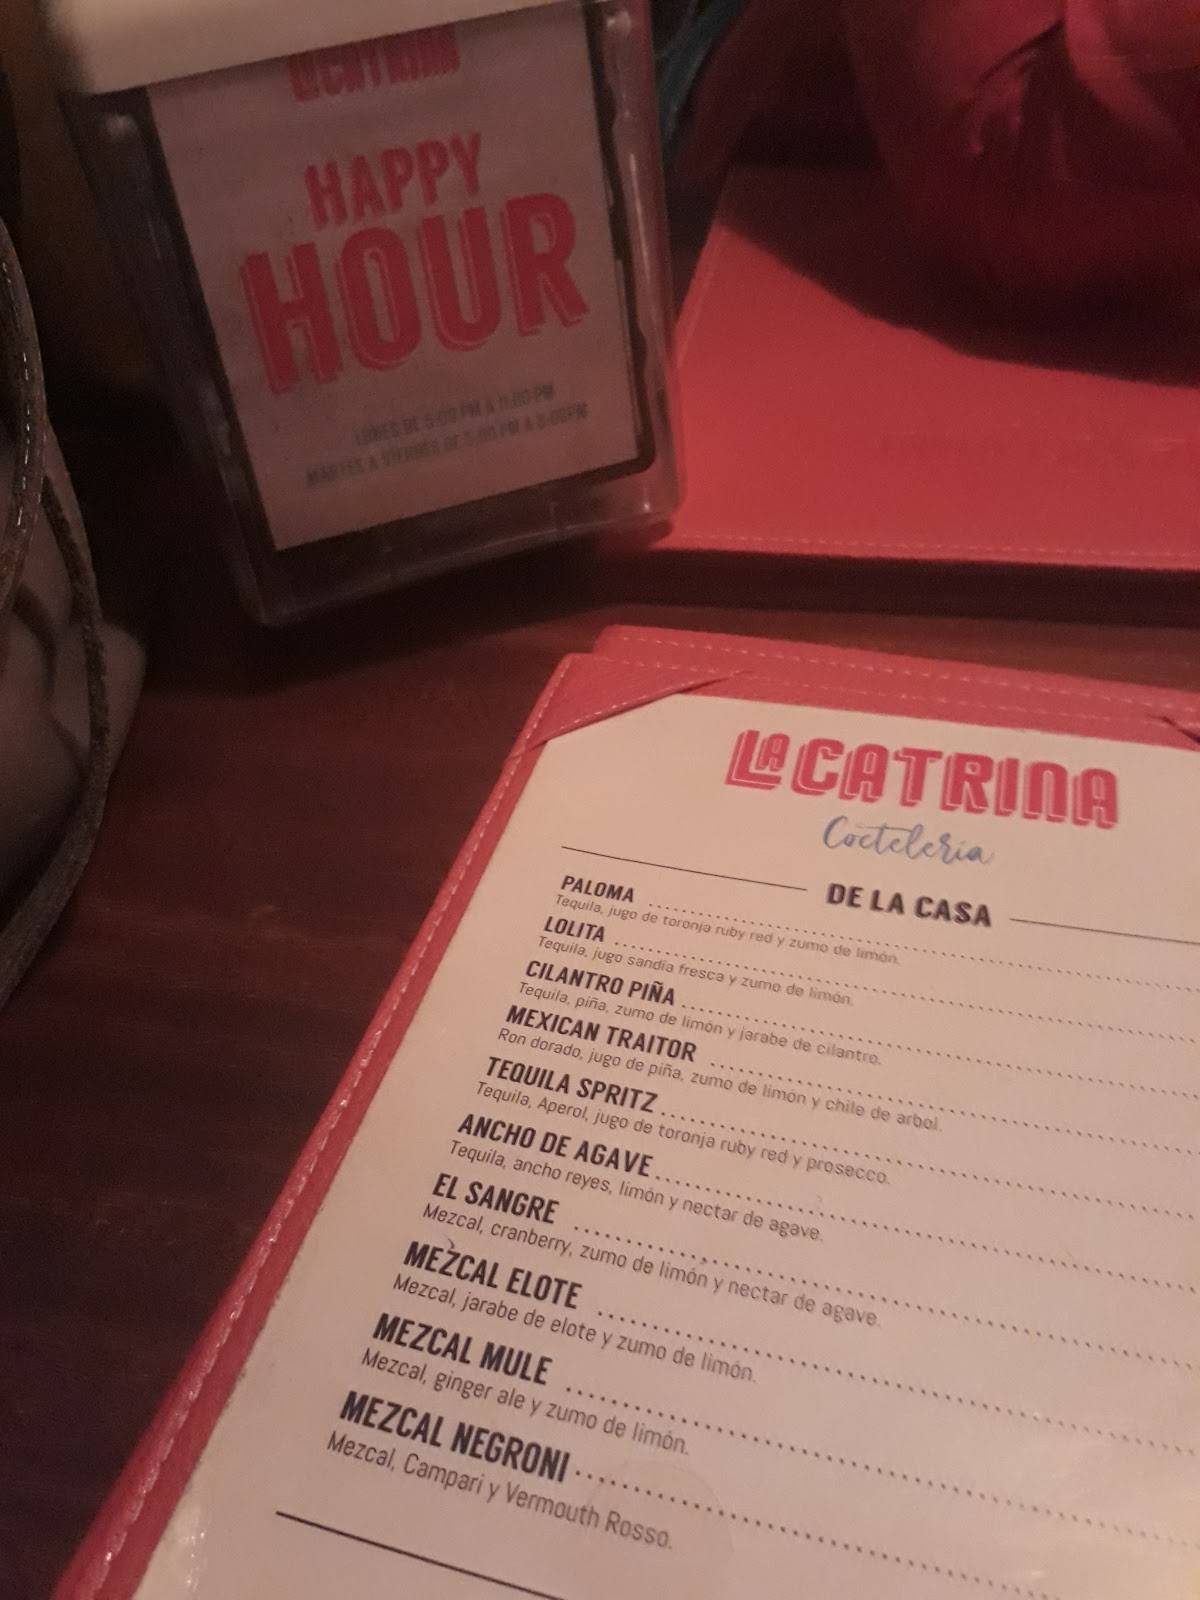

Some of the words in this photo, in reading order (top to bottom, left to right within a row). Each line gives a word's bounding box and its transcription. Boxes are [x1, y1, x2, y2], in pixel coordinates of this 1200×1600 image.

[304, 132, 482, 231] HAPPY
[239, 192, 590, 395] HOUR
[724, 729, 791, 790] LA
[791, 737, 1119, 830] CATRINA
[556, 893, 603, 915] Tequila,
[607, 907, 639, 921] jugo
[641, 911, 659, 924] de
[663, 915, 712, 934] toronja
[715, 926, 746, 941] ruby
[749, 932, 774, 944] red
[776, 936, 786, 948] y
[788, 938, 829, 953] zumo
[833, 944, 852, 957] de
[856, 947, 901, 964] limón.
[560, 874, 634, 904] PALOMA
[825, 881, 864, 908] DE
[868, 887, 906, 915] LA
[913, 894, 992, 927] CASA
[543, 915, 605, 943] LOLITA
[525, 960, 625, 995] CILANTRO
[627, 980, 675, 1007] PIÑA
[538, 935, 588, 958] Tequila,
[591, 947, 624, 964] jugo
[678, 963, 725, 983] fresca
[728, 974, 738, 987] y
[740, 976, 782, 993] zumo
[785, 983, 805, 997] de
[808, 986, 853, 1006] limón.
[505, 1004, 601, 1042] MEXICAN
[606, 1025, 697, 1063] TRAITOR
[519, 981, 570, 1005] Tequila,
[574, 996, 609, 1014] piña,
[614, 1004, 655, 1022] zumo
[659, 1012, 678, 1026] de
[681, 1015, 723, 1035] limón
[727, 1027, 736, 1040] y
[739, 1026, 788, 1048] jarabe
[792, 1038, 812, 1053] de
[816, 1043, 881, 1065] cilantro.
[486, 1055, 571, 1095] TEQUILA
[575, 1077, 659, 1114] SPRITZ
[497, 1027, 527, 1046] Ron
[529, 1036, 584, 1061] dorado,
[587, 1047, 622, 1068] jugo
[625, 1057, 645, 1072] de
[647, 1063, 684, 1082] piña,
[689, 1072, 734, 1091] zumo
[737, 1079, 758, 1096] de
[762, 1083, 807, 1105] limón
[811, 1096, 821, 1110] y
[825, 1097, 866, 1117] chile
[870, 1105, 891, 1123] de
[896, 1113, 942, 1132] arbol.
[456, 1113, 537, 1149] ANCHO
[539, 1131, 572, 1158] DE
[572, 1140, 654, 1178] AGAVE
[476, 1080, 532, 1109] Tequila,
[536, 1097, 589, 1122] Aperol,
[592, 1112, 629, 1131] jugo
[633, 1119, 654, 1135] de
[658, 1124, 716, 1149] toronja
[719, 1139, 756, 1159] ruby
[760, 1147, 789, 1165] red
[792, 1154, 803, 1169] y
[805, 1157, 890, 1185] prosecco.
[431, 1172, 459, 1201] EL
[464, 1180, 560, 1225] SANGRE
[450, 1139, 506, 1170] Tequila,
[512, 1158, 562, 1180] ancho
[564, 1171, 613, 1195] reyes,
[618, 1180, 665, 1205] limón
[668, 1196, 679, 1211] y
[681, 1199, 739, 1222] nectar
[742, 1210, 764, 1229] de
[768, 1218, 823, 1242] agave.
[402, 1240, 500, 1289] MEZCAL
[505, 1267, 584, 1310] ELOTE
[422, 1202, 484, 1235] Mezcal,
[490, 1223, 573, 1257] cranberry,
[579, 1244, 628, 1269] zumo
[631, 1255, 654, 1275] de
[658, 1260, 708, 1288] limón
[713, 1277, 724, 1295] y
[727, 1280, 789, 1306] nectar
[793, 1293, 816, 1313] de
[821, 1302, 880, 1327] agave.
[372, 1312, 473, 1365] MEZCAL
[479, 1341, 554, 1387] MULE
[392, 1273, 457, 1309] Mezcal,
[459, 1291, 519, 1322] jarabe
[523, 1309, 546, 1329] de
[549, 1317, 597, 1343] elote
[600, 1331, 613, 1350] y
[615, 1335, 667, 1360] zumo
[672, 1346, 696, 1368] de
[700, 1351, 756, 1383] limón.
[339, 1390, 445, 1448] MEZCAL
[450, 1421, 571, 1484] NEGRONI
[360, 1347, 428, 1385] Mezcal,
[433, 1371, 494, 1400] ginger
[496, 1388, 526, 1410] ale
[529, 1399, 543, 1417] y
[545, 1402, 598, 1430] zumo
[602, 1415, 627, 1439] de
[631, 1421, 689, 1456] limón.
[326, 1430, 396, 1472] Mezcal,
[403, 1452, 485, 1495] Campari
[486, 1482, 501, 1504] y
[506, 1481, 600, 1528] Vermouth
[604, 1510, 673, 1550] Rosso.
